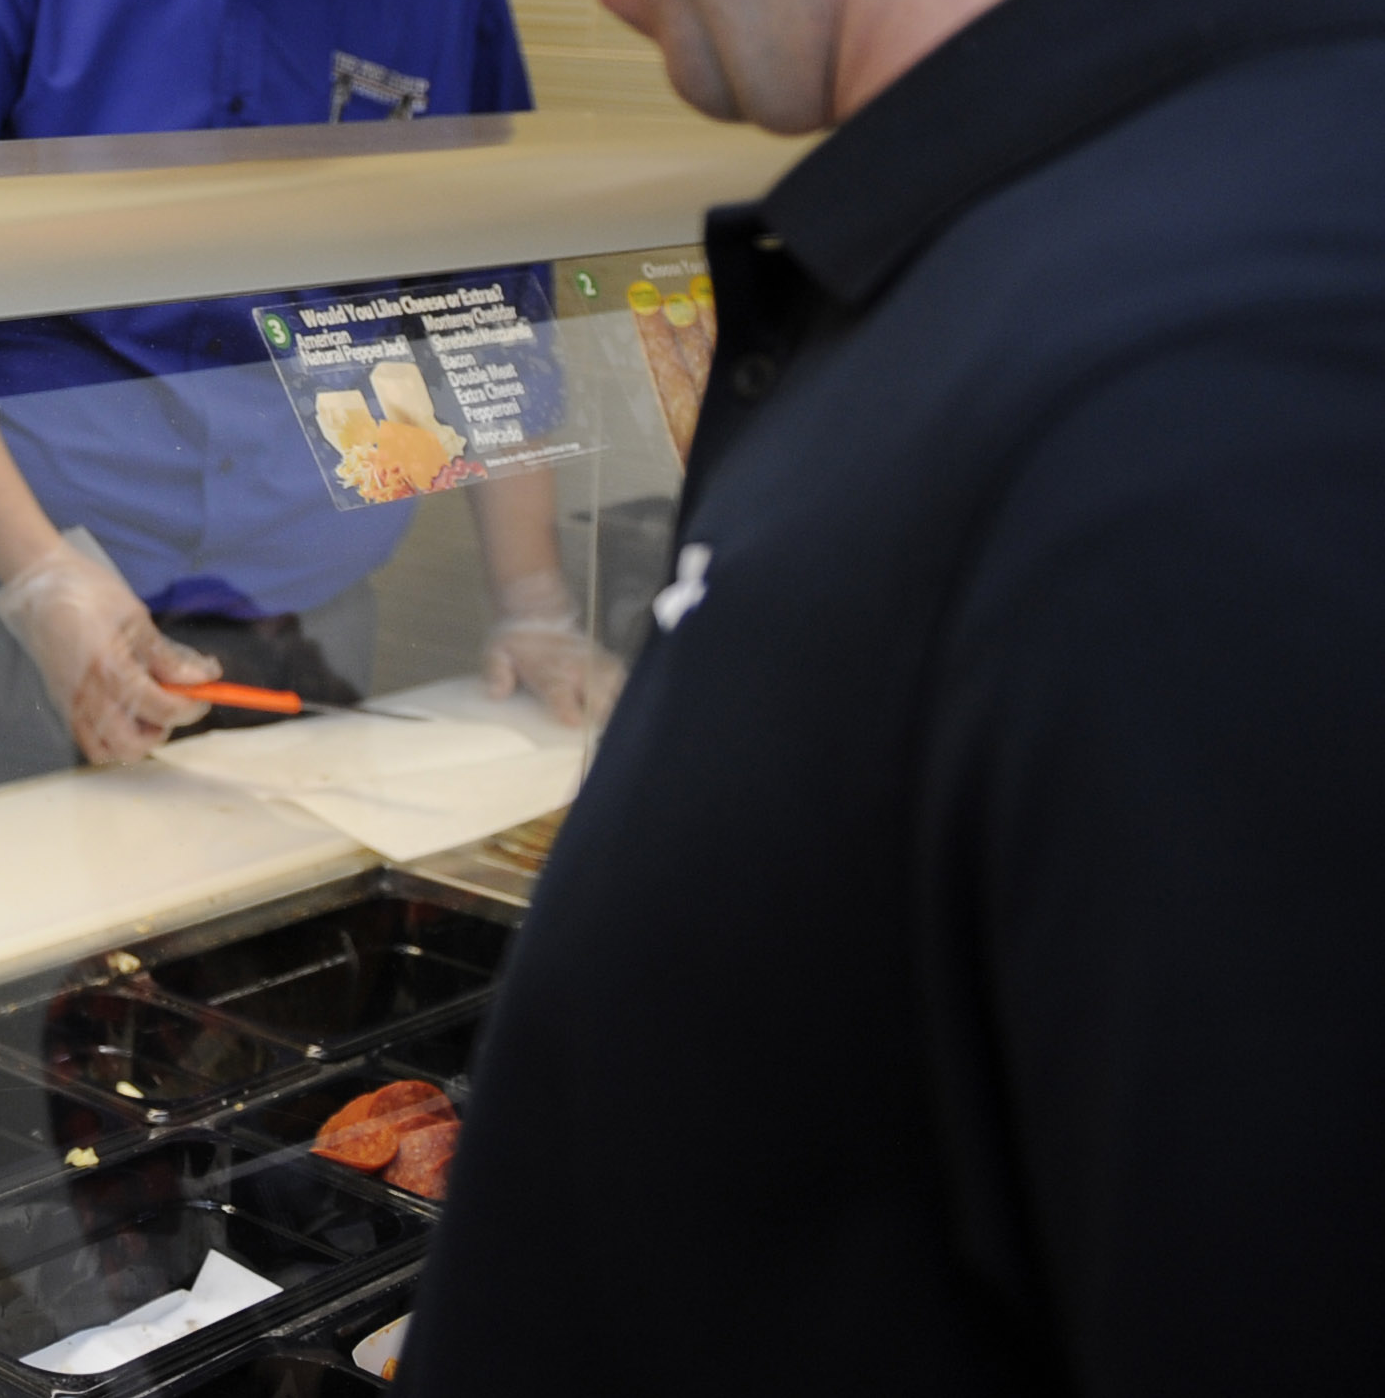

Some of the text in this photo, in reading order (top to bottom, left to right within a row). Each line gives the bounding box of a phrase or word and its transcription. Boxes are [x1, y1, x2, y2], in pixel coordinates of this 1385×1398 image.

[578, 272, 598, 297] 2
[298, 283, 505, 329] Would You Like Cheese Extras?
[267, 318, 288, 344] 3
[295, 328, 353, 350] American
[301, 341, 385, 368] Natural Pepper
[438, 352, 478, 371] Bacon
[445, 365, 490, 388] Double
[483, 380, 526, 401] Cheese
